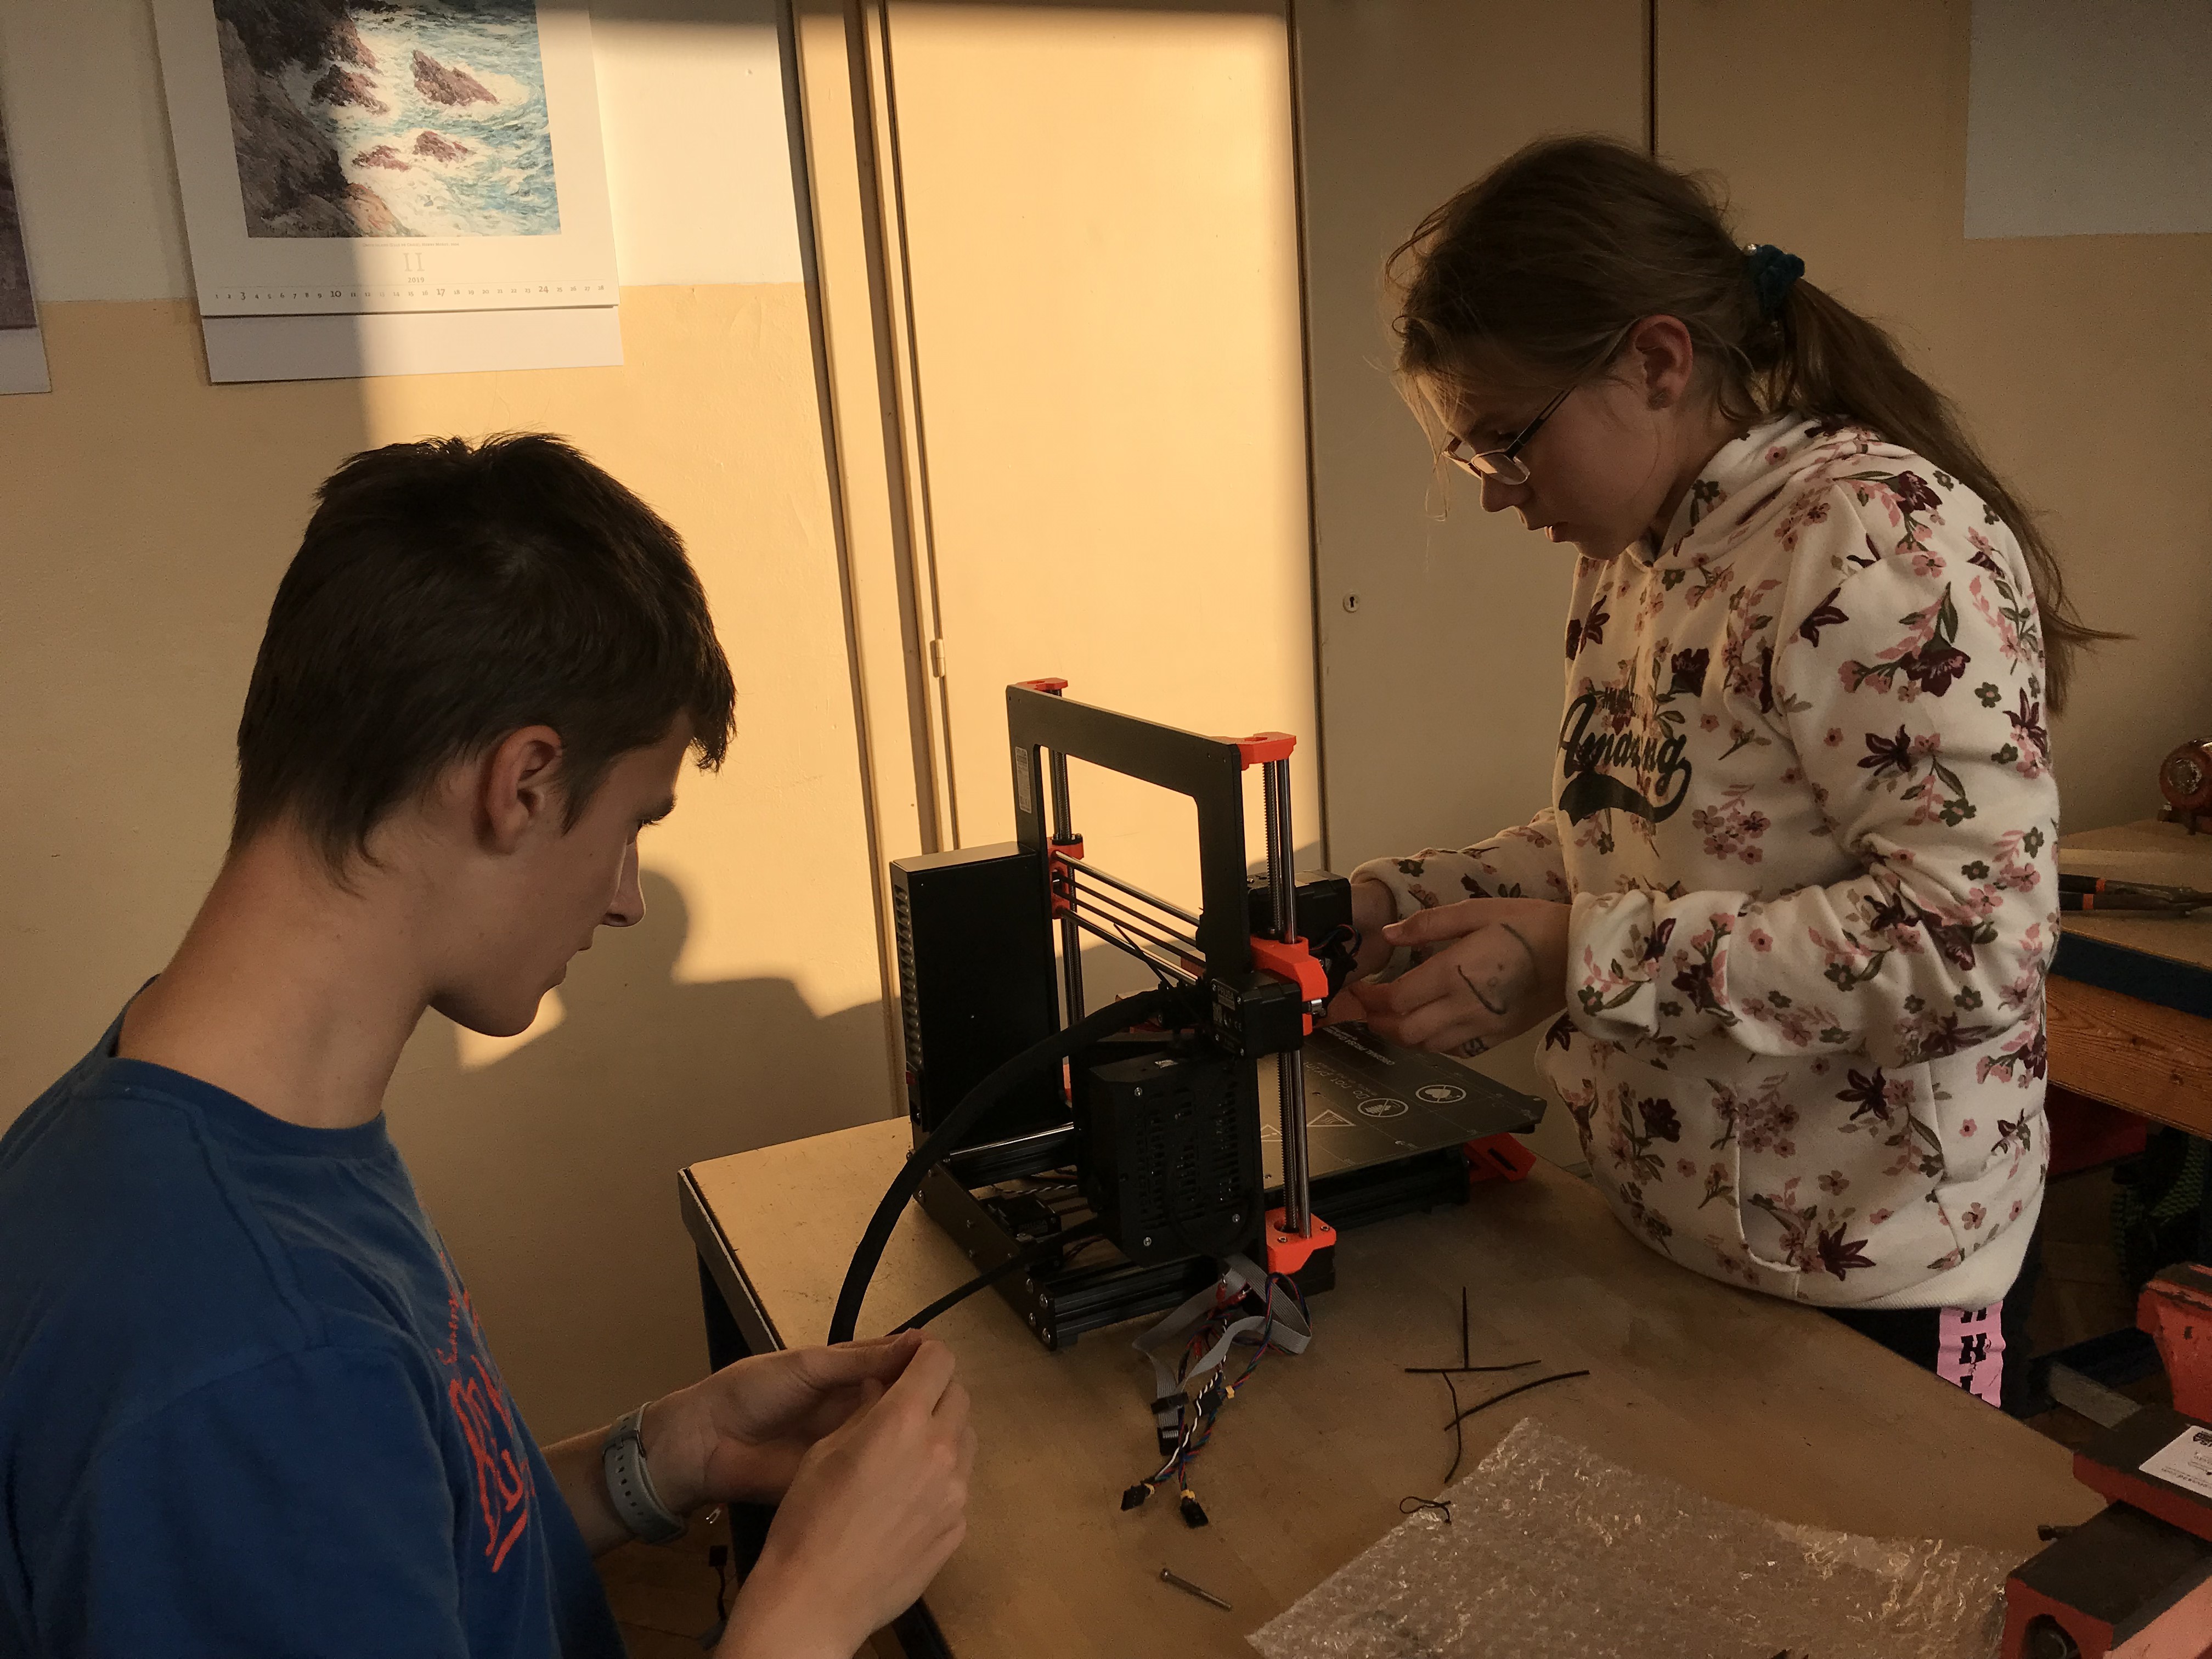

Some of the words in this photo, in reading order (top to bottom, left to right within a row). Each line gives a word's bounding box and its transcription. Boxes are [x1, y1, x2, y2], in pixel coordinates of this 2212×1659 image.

[240, 291, 246, 301] 3
[436, 288, 446, 297] 17
[538, 285, 550, 294] 24
[1331, 1079, 1352, 1088] not
[1353, 1090, 1370, 1099] Do
